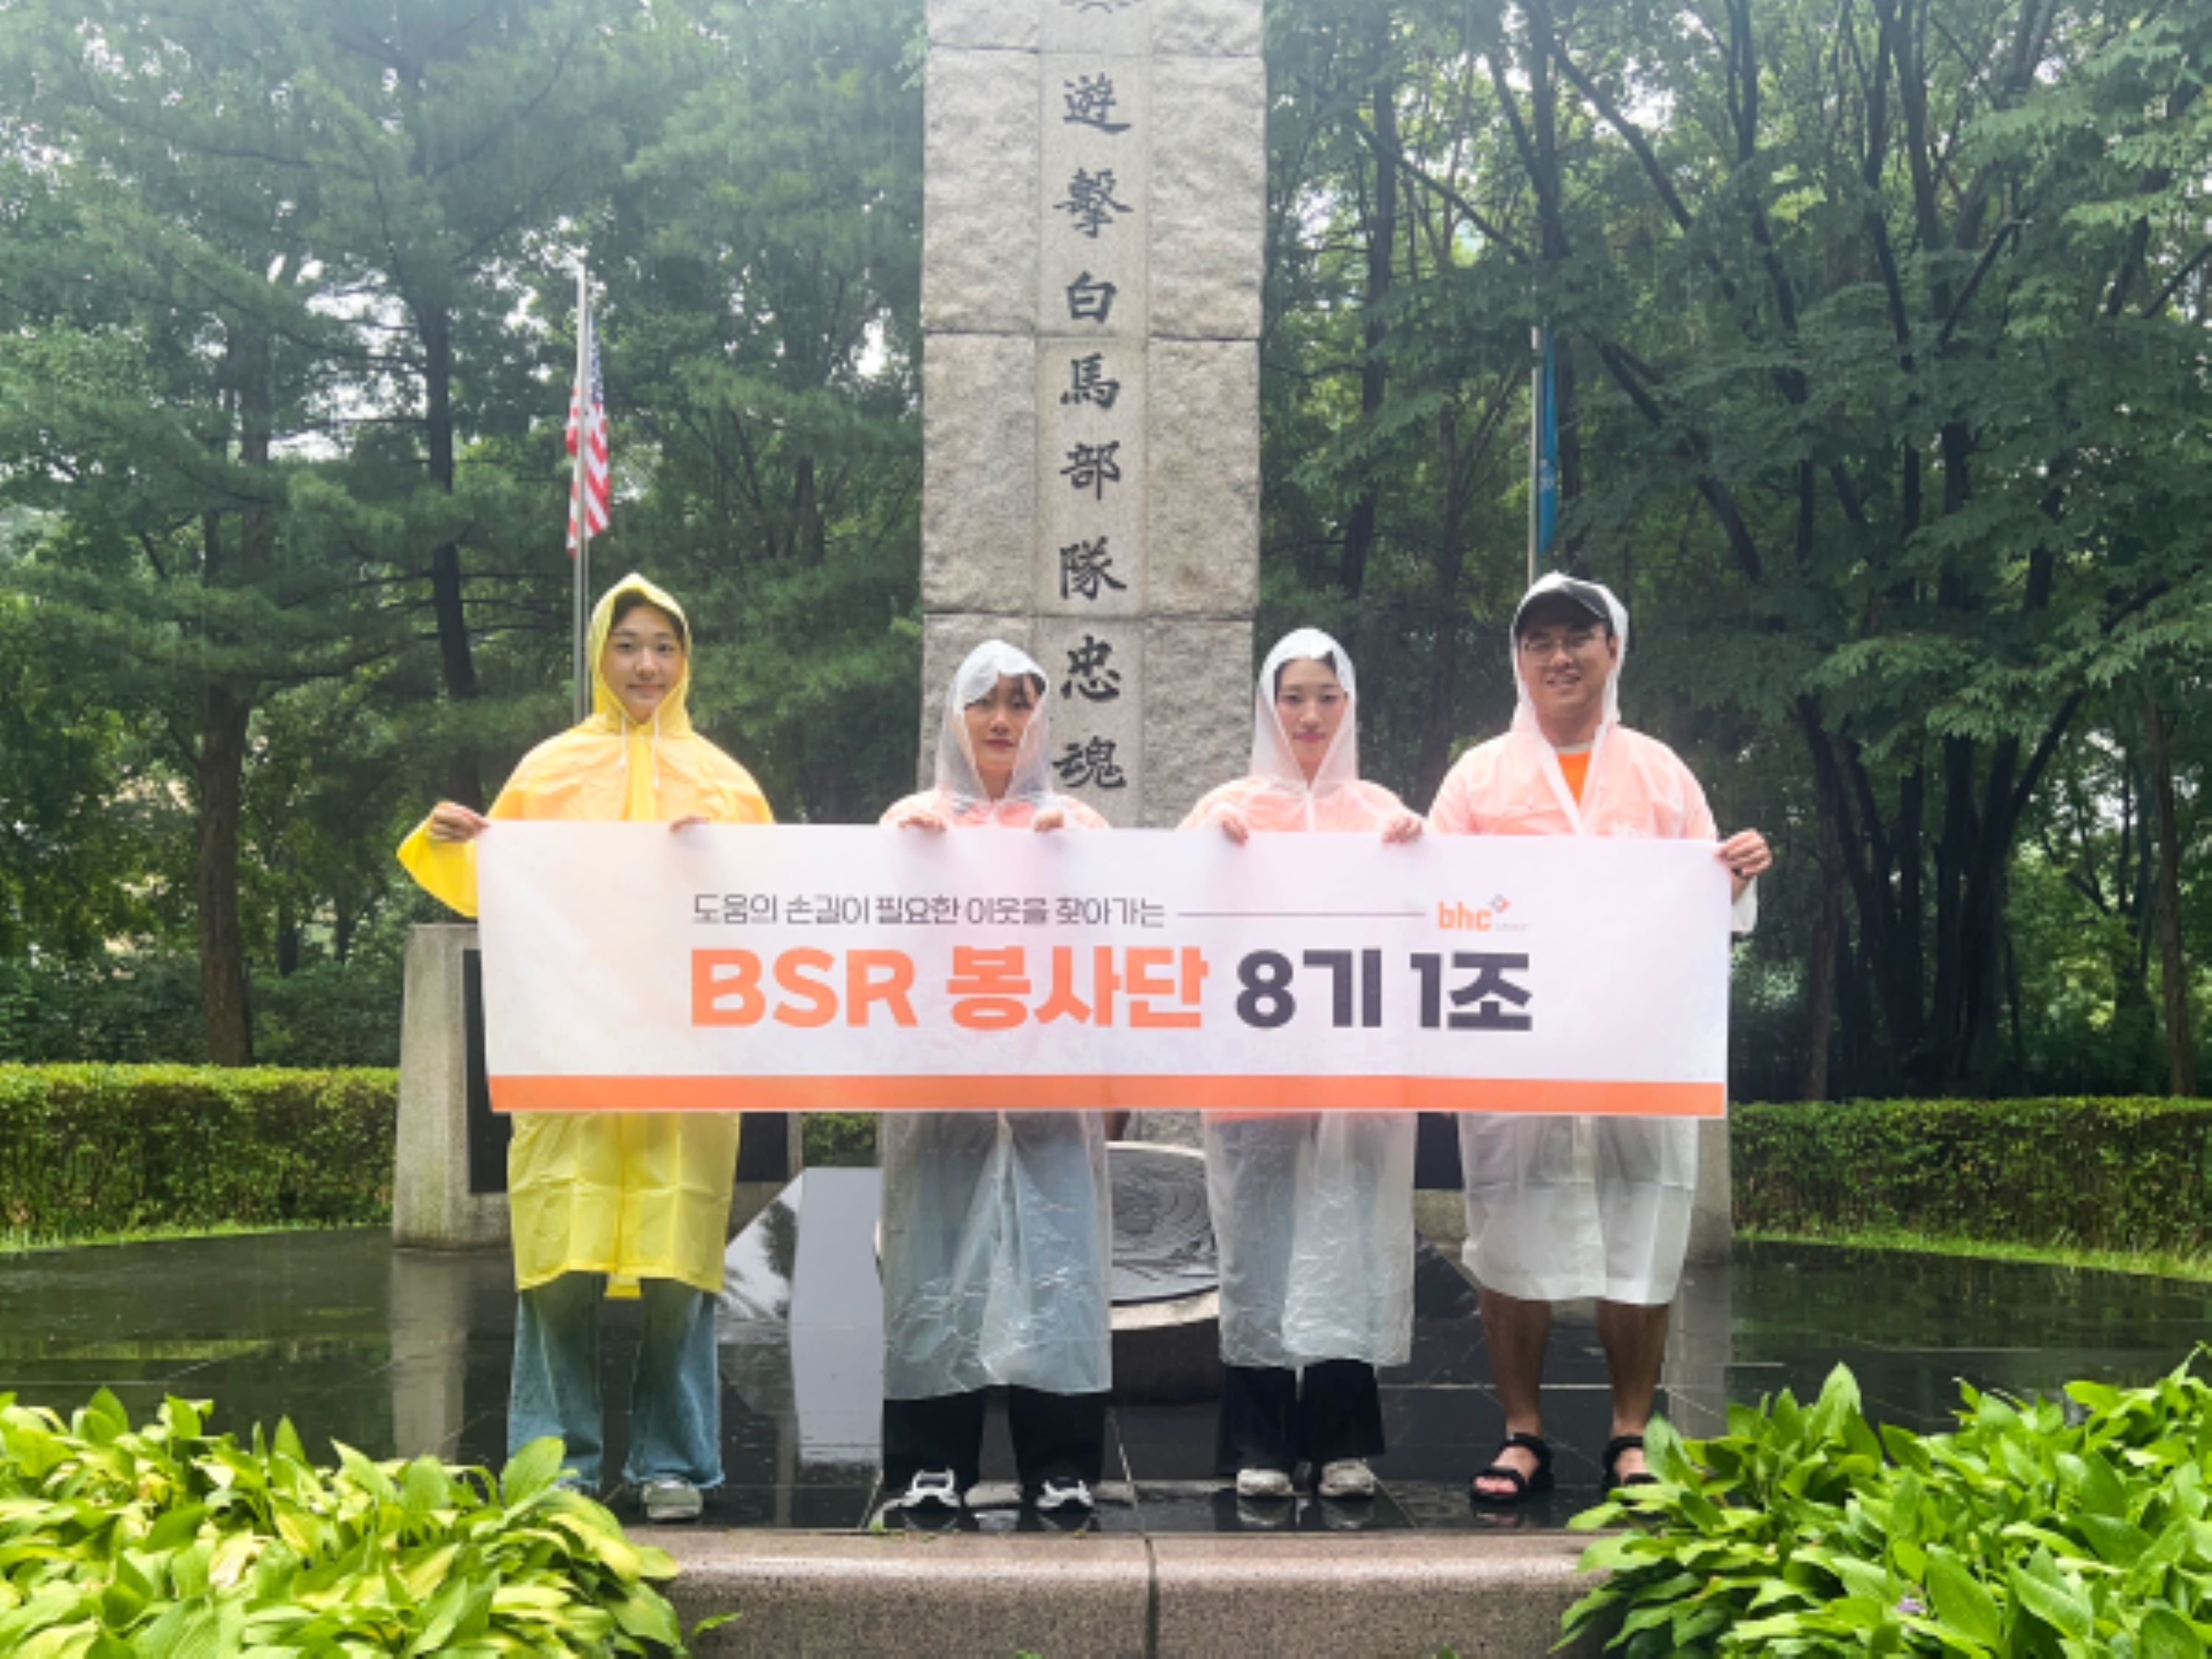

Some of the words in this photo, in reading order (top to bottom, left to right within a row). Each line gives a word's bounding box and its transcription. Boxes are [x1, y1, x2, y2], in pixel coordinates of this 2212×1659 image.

[1053, 0, 1134, 789] 遊擊白馬部隊忠魂
[692, 894, 777, 924] 도움의
[785, 894, 869, 924] 손길이
[875, 895, 959, 924] 필요한
[965, 897, 1048, 925] 이웃을
[1055, 897, 1165, 928] 찾아가는
[1438, 900, 1492, 931] bhc
[691, 947, 918, 1028] BSR
[946, 946, 1209, 1030] 봉사단
[1235, 949, 1382, 1029] 8기
[1410, 951, 1533, 1032] 1조
